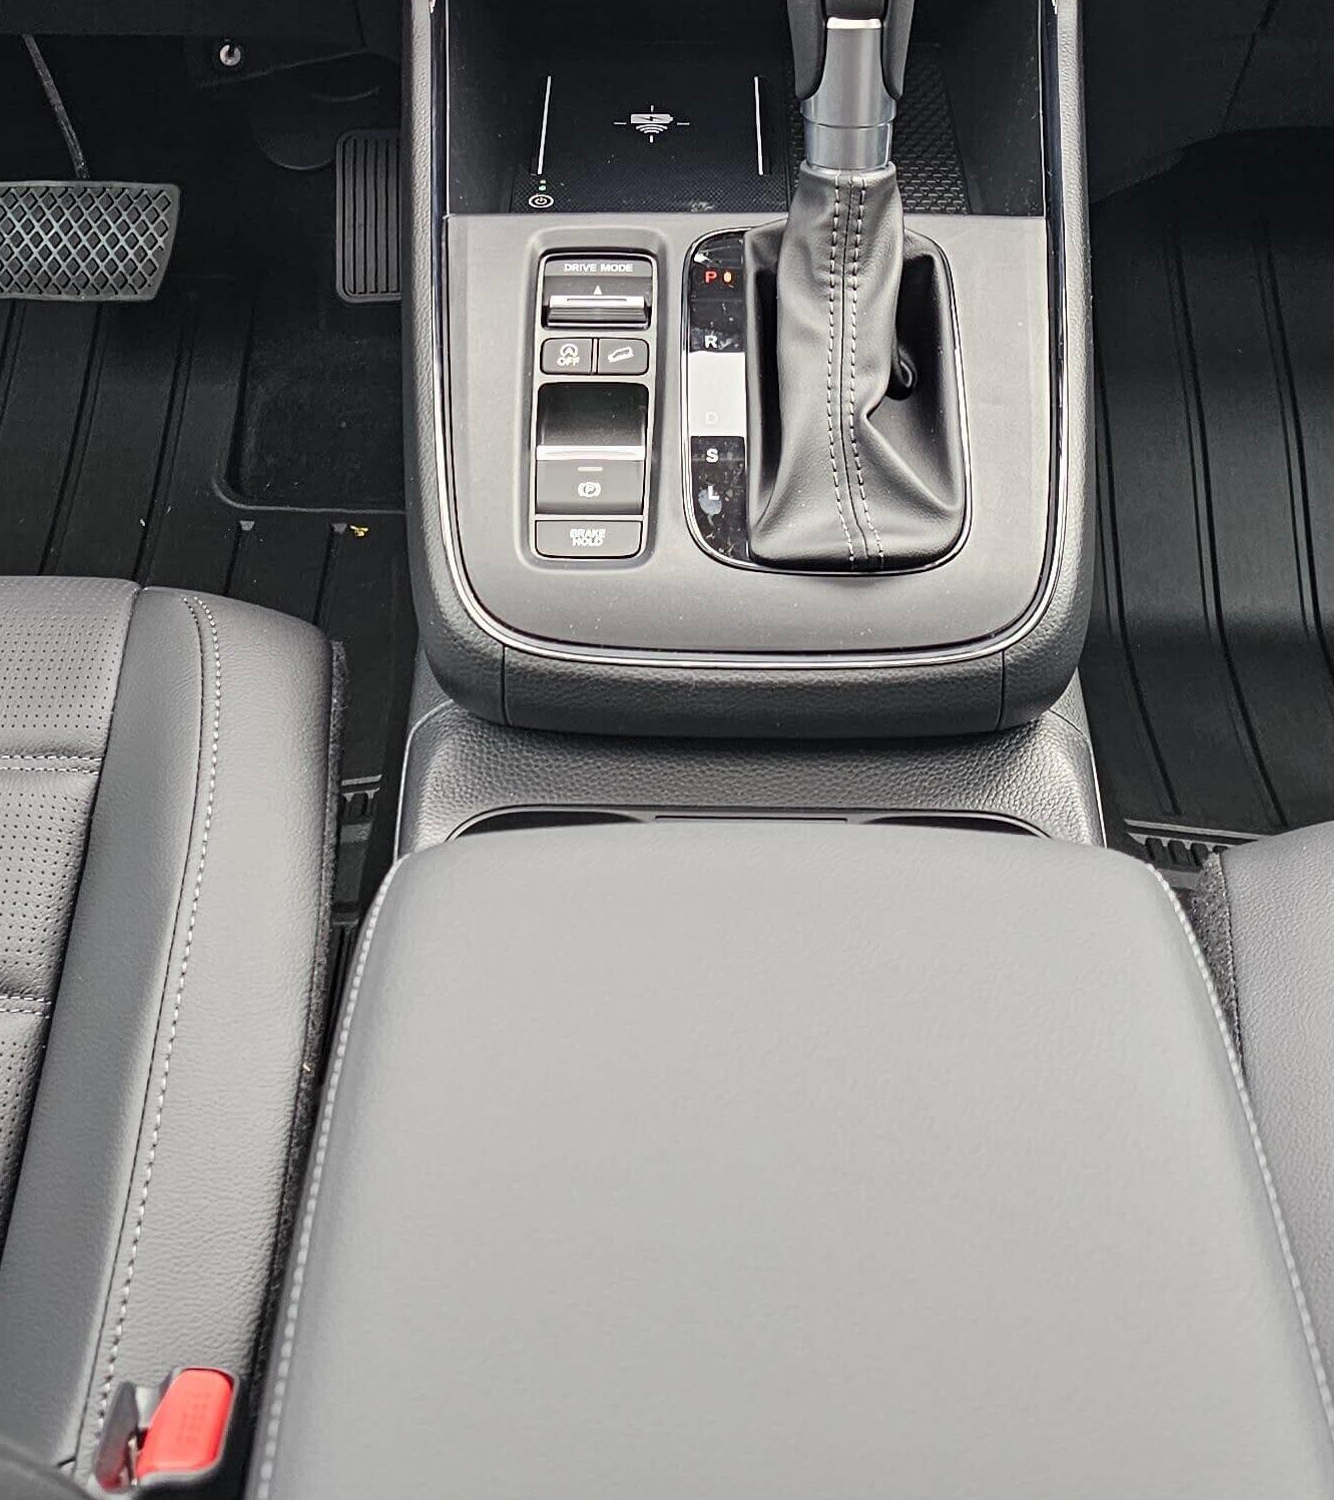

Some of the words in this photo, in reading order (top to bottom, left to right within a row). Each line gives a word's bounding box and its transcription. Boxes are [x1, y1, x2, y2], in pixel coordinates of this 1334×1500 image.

[563, 263, 598, 273] DRIVE
[600, 263, 634, 273] MODE
[705, 271, 717, 283] P
[705, 335, 718, 348] R
[555, 356, 581, 367] OFF
[705, 448, 718, 463] S
[708, 486, 720, 501] L
[569, 528, 606, 538] BRAKE
[572, 537, 604, 547] HOLD
